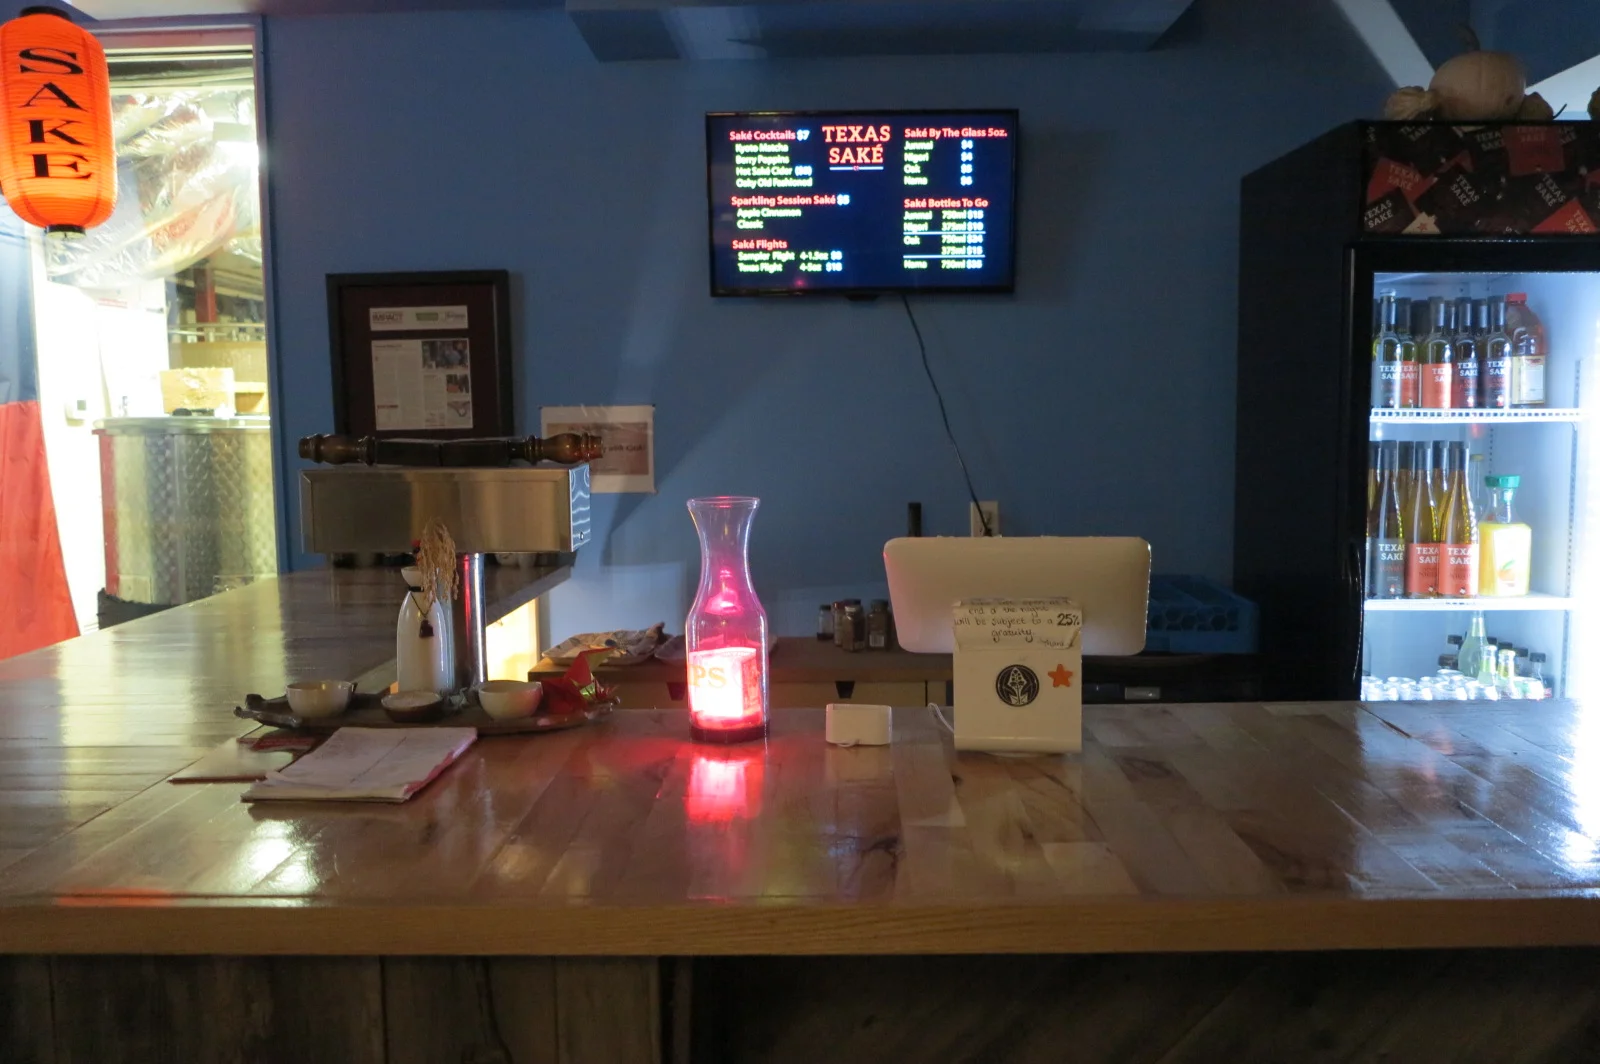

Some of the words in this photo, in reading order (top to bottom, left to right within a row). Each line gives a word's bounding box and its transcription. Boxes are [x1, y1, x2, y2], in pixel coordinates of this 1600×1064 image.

[17, 47, 93, 180] SAKE
[730, 131, 752, 140] Saké
[754, 130, 795, 140] Cocktails
[797, 130, 810, 141] $7
[822, 125, 891, 142] TEXAS
[905, 128, 927, 137] Saké
[929, 128, 941, 139] By
[942, 128, 960, 137] The
[961, 128, 986, 137] Glass
[988, 128, 1007, 137] 5oz.
[1475, 131, 1502, 142] TEXA
[735, 144, 758, 154] Kyoto
[759, 143, 789, 153] Matcha
[904, 141, 933, 150] Junmai
[829, 144, 884, 164] SAKÉ
[904, 152, 929, 163] Nigori
[735, 155, 757, 165] Berry
[736, 166, 751, 175] Hot
[752, 166, 770, 175] Saké
[771, 166, 792, 175] Cider
[904, 164, 920, 174] Oak
[736, 178, 757, 189] Oaky
[757, 178, 772, 187] Old
[773, 177, 813, 187] Fashioned
[904, 176, 928, 185] Nama
[1456, 174, 1480, 202] TEXAS
[1543, 174, 1567, 203] TEXAS
[1450, 183, 1471, 207] SAKE
[731, 196, 776, 207] Sparkling
[777, 196, 812, 205] Session
[814, 195, 836, 204] Saké
[904, 199, 927, 208] Saké
[928, 199, 961, 208] Bottles
[962, 198, 973, 207] To
[975, 198, 988, 207] Go
[737, 208, 760, 219] Apple
[761, 208, 802, 217] Cinnamon
[904, 211, 932, 220] Junmai
[1368, 209, 1394, 228] SAKE
[737, 220, 764, 229] Classic
[904, 222, 928, 233] Nigori
[733, 240, 755, 249] Saké
[757, 240, 788, 250] Flights
[904, 235, 920, 245] Oak
[738, 252, 770, 262] Sampler
[772, 251, 795, 262] Flight
[738, 262, 760, 272] Texas
[760, 262, 783, 273] Flight
[904, 260, 928, 269] Nama
[1416, 547, 1439, 555] TEXA
[1447, 548, 1472, 556] TEXA
[954, 618, 971, 626] will
[976, 618, 987, 626] be
[991, 618, 1026, 629] subject
[1057, 613, 1080, 627] 25%
